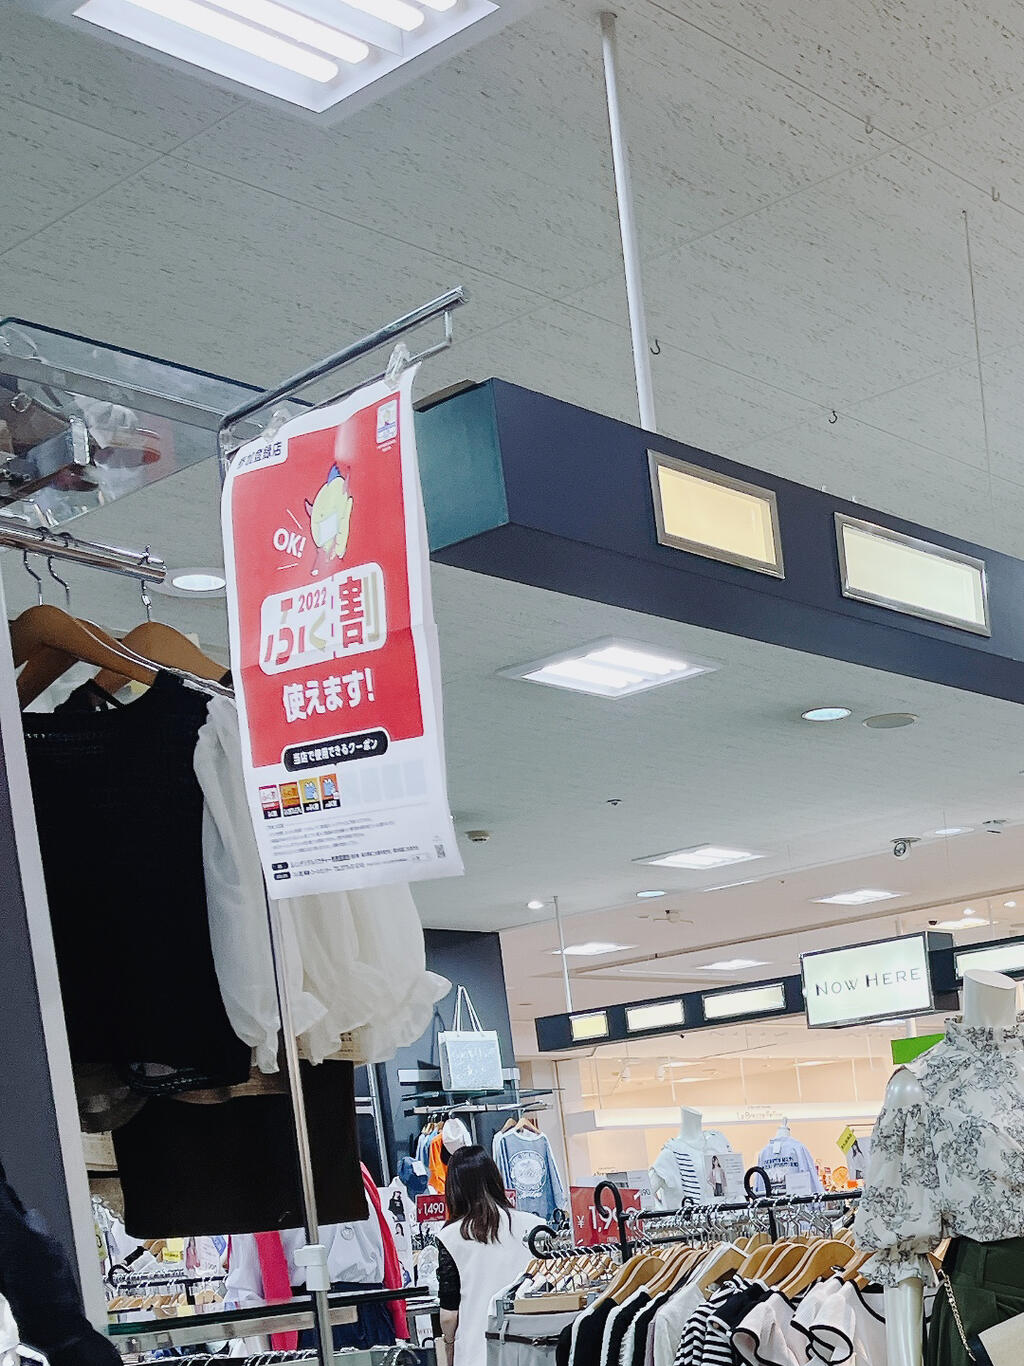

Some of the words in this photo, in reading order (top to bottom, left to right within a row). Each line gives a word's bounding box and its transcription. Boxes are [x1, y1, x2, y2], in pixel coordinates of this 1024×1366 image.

[272, 528, 306, 559] OK!
[298, 587, 327, 613] 2022
[283, 667, 375, 724] 使えます!
[815, 979, 858, 997] NOW
[865, 968, 921, 988] HERE
